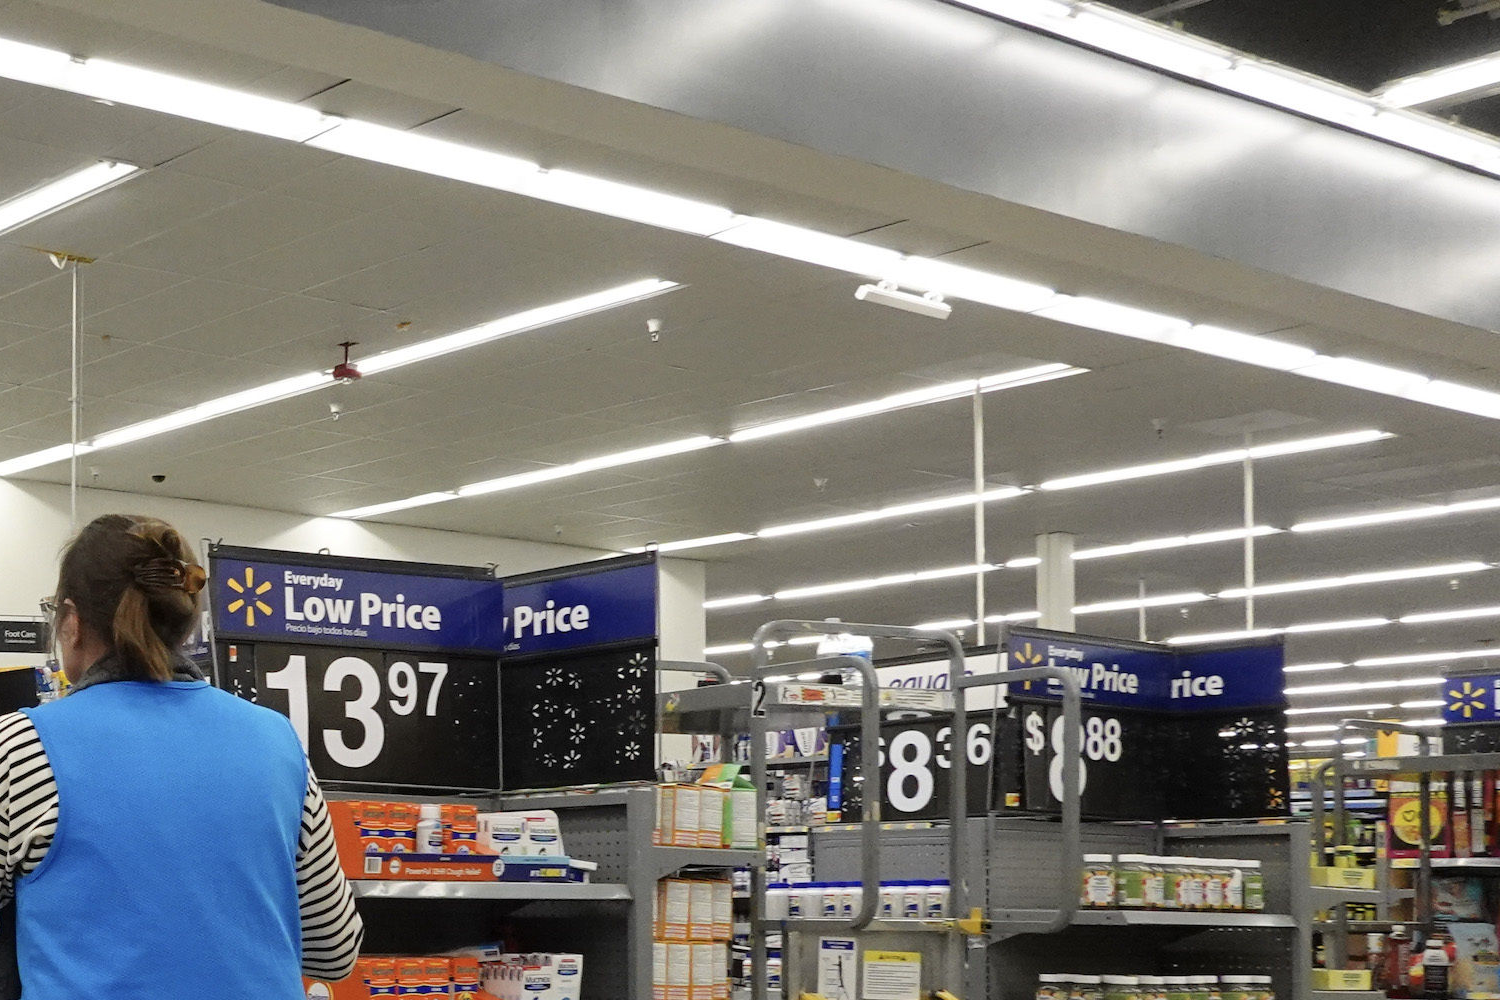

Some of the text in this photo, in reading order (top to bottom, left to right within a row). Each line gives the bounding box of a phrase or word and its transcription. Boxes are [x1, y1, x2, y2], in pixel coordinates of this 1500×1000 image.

[284, 571, 343, 591] Everyday
[285, 587, 441, 631] Low Price
[514, 600, 589, 638] Price
[5, 630, 19, 638] Foot
[285, 623, 306, 633] Precio
[307, 625, 322, 635] bajo
[323, 627, 342, 635] todos
[343, 628, 352, 636] los
[1091, 663, 1139, 694] Price
[1171, 670, 1224, 698] rice
[752, 682, 765, 716] 2
